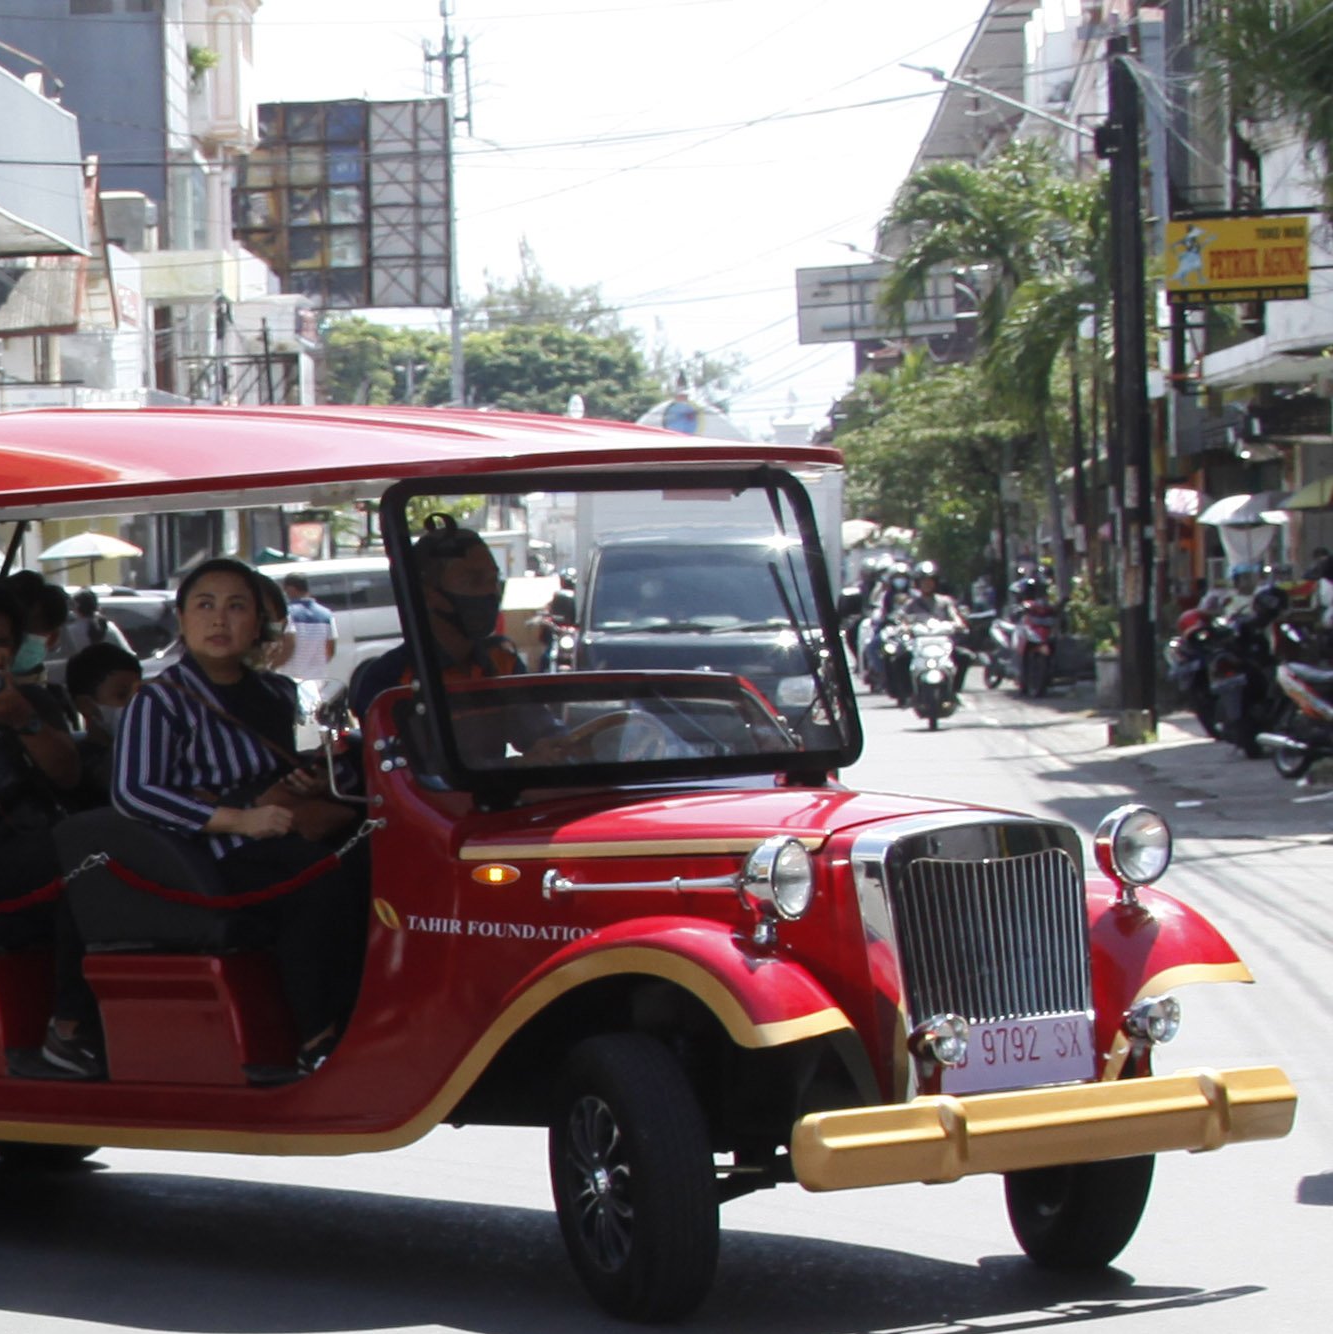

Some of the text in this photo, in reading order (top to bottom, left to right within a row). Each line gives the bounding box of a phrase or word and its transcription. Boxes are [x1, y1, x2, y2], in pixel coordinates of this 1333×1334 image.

[407, 914, 462, 935] TAHIR
[981, 1025, 1040, 1065] 9792
[1053, 1019, 1082, 1058] SX
